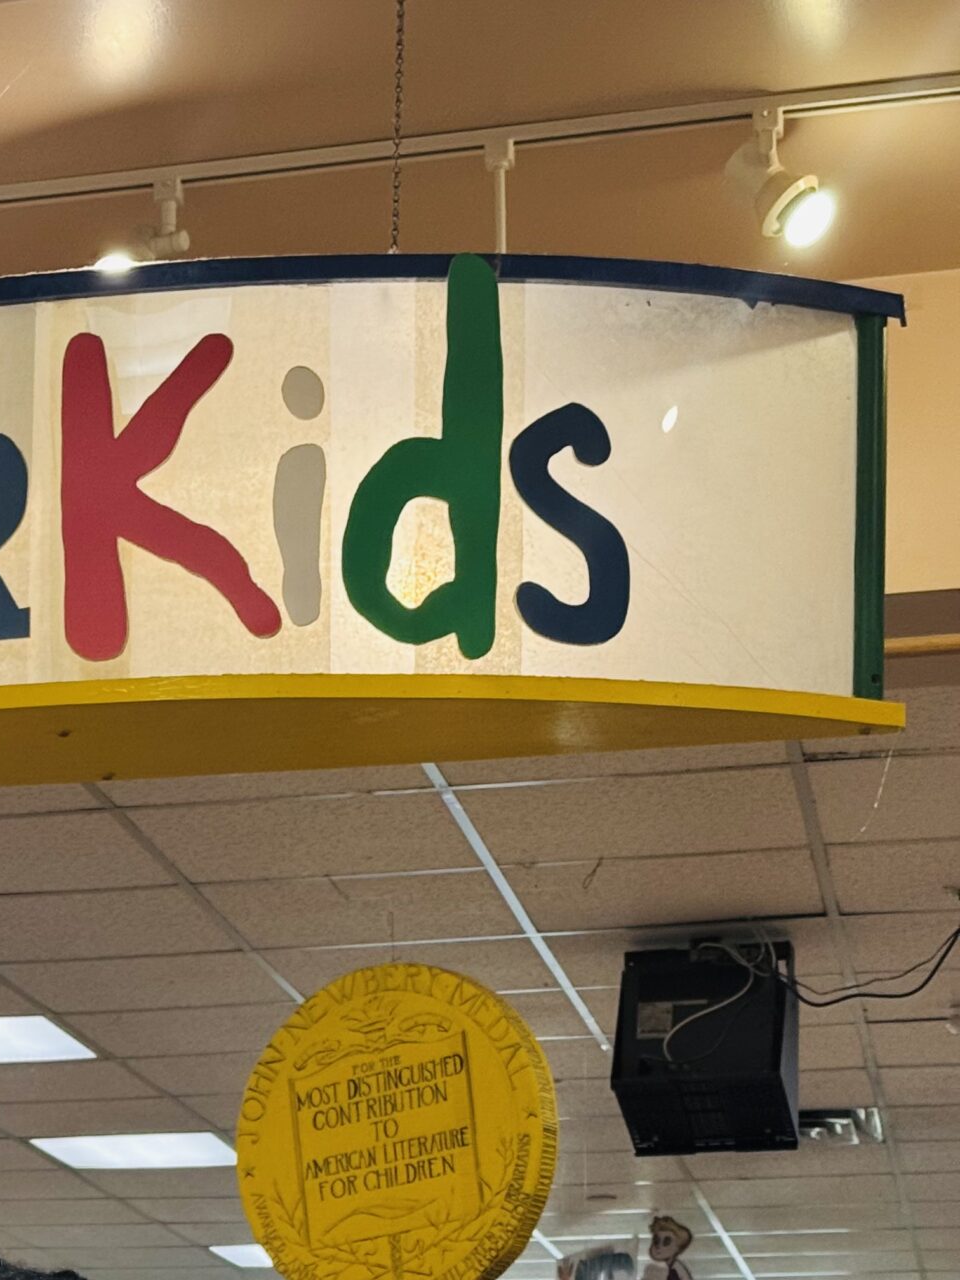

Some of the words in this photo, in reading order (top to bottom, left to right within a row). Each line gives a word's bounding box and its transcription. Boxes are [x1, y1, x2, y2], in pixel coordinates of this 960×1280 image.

[296, 1082, 341, 1112] MOST
[347, 1053, 465, 1100] DISTINGUISHED
[352, 1061, 376, 1076] FOR
[379, 1055, 401, 1067] THE
[312, 1080, 448, 1131] CONTRIBUTION
[370, 1118, 399, 1142] TO
[305, 1146, 377, 1181] AMERICAN
[383, 1126, 470, 1165] LITERATURE
[318, 1174, 358, 1201] FOR
[363, 1154, 456, 1192] CHILDREN
